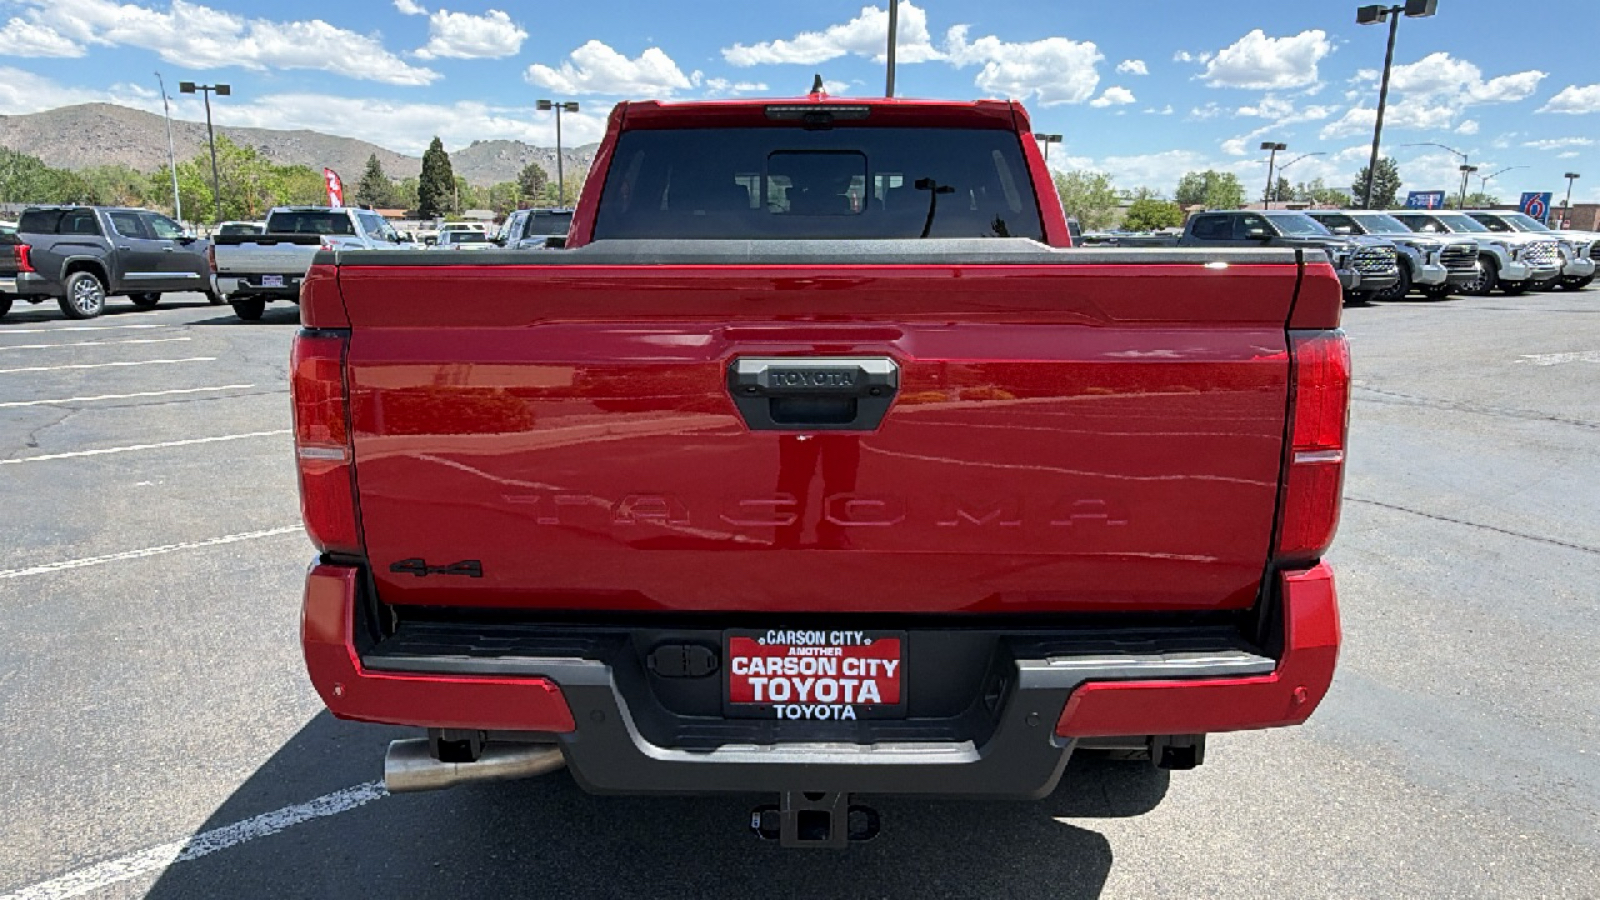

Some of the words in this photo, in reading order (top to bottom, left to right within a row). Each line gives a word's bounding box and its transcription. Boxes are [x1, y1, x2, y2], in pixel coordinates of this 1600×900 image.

[772, 372, 853, 387] TOYOTA
[501, 492, 1128, 526] TACOMA
[766, 630, 826, 646] CARSON
[830, 631, 863, 645] CITY
[788, 647, 843, 656] ANOTHER
[732, 657, 837, 676] CARSON
[842, 659, 899, 678] CITY
[748, 677, 881, 703] TOYOTA
[773, 704, 856, 720] TOYOTA
